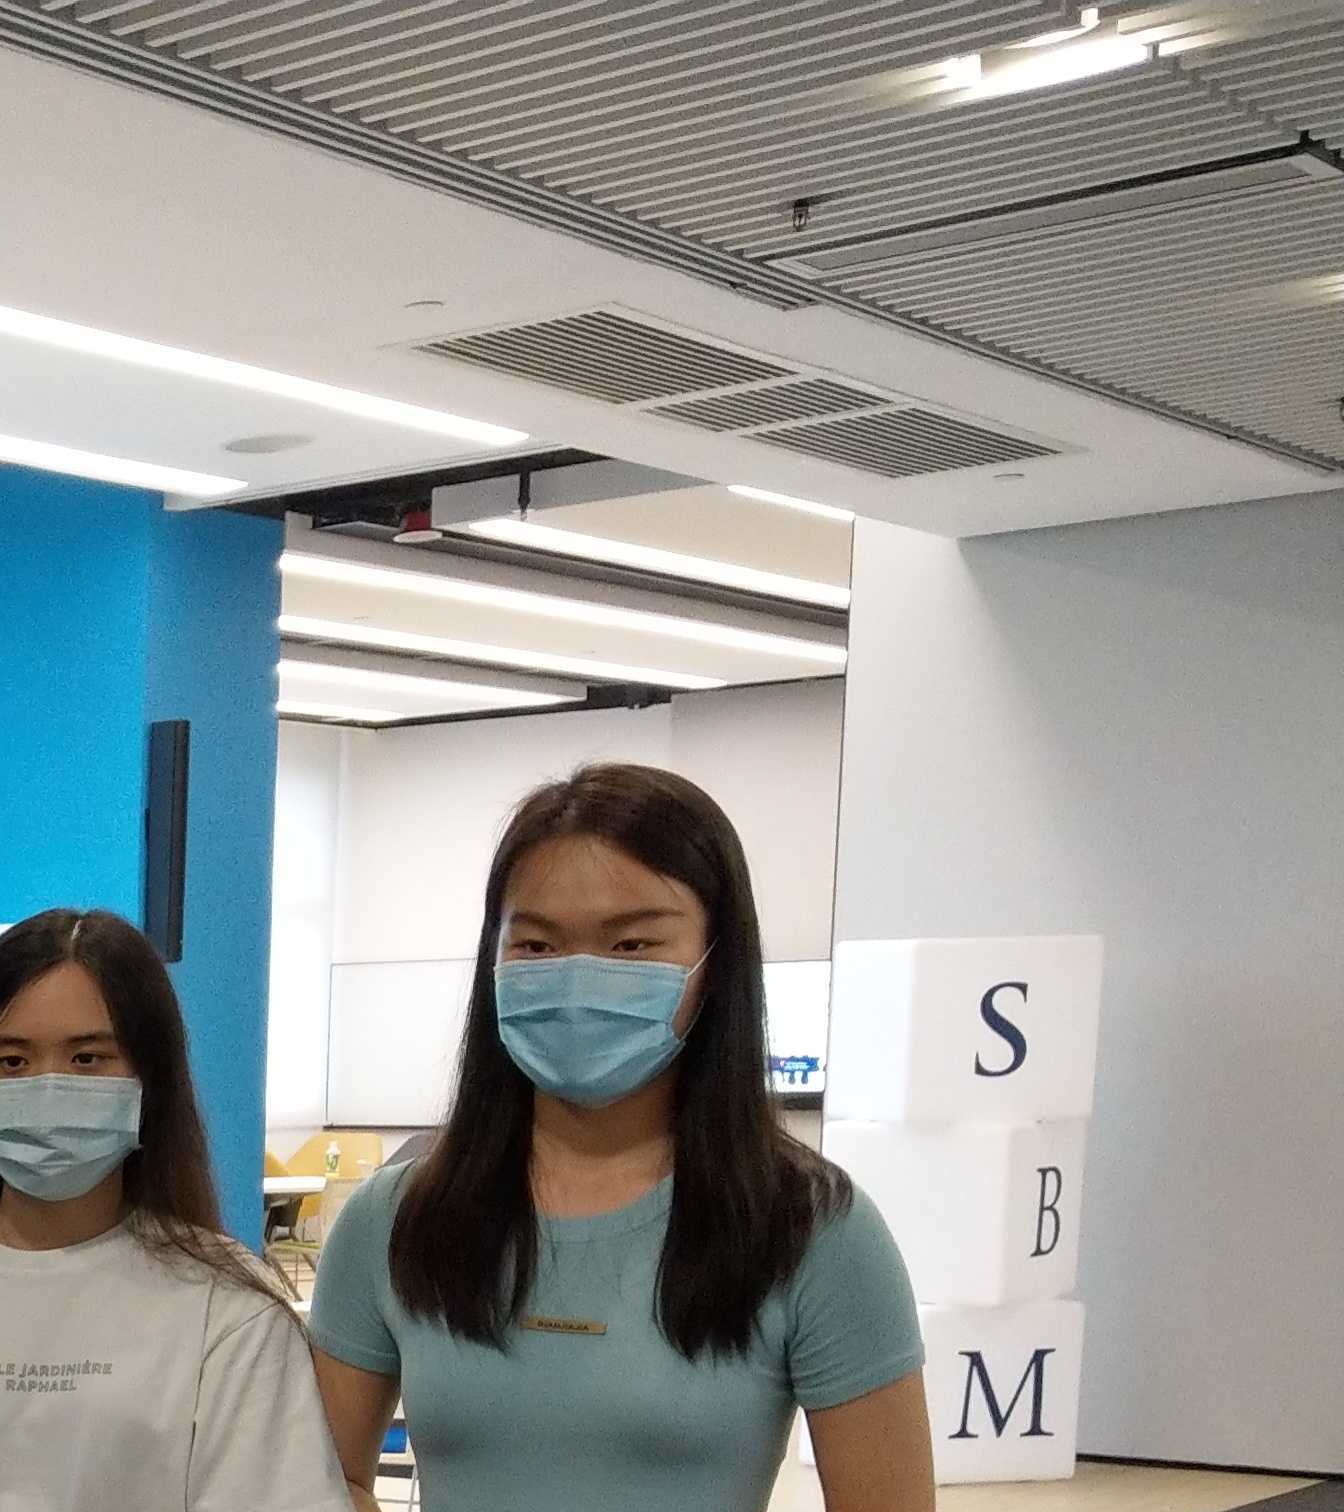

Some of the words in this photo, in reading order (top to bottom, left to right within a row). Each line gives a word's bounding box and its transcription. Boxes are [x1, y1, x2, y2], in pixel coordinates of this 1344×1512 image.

[974, 981, 1030, 1078] S
[1030, 1166, 1063, 1258] B
[5, 1378, 78, 1392] RAPHAEL
[948, 1348, 1057, 1440] M
